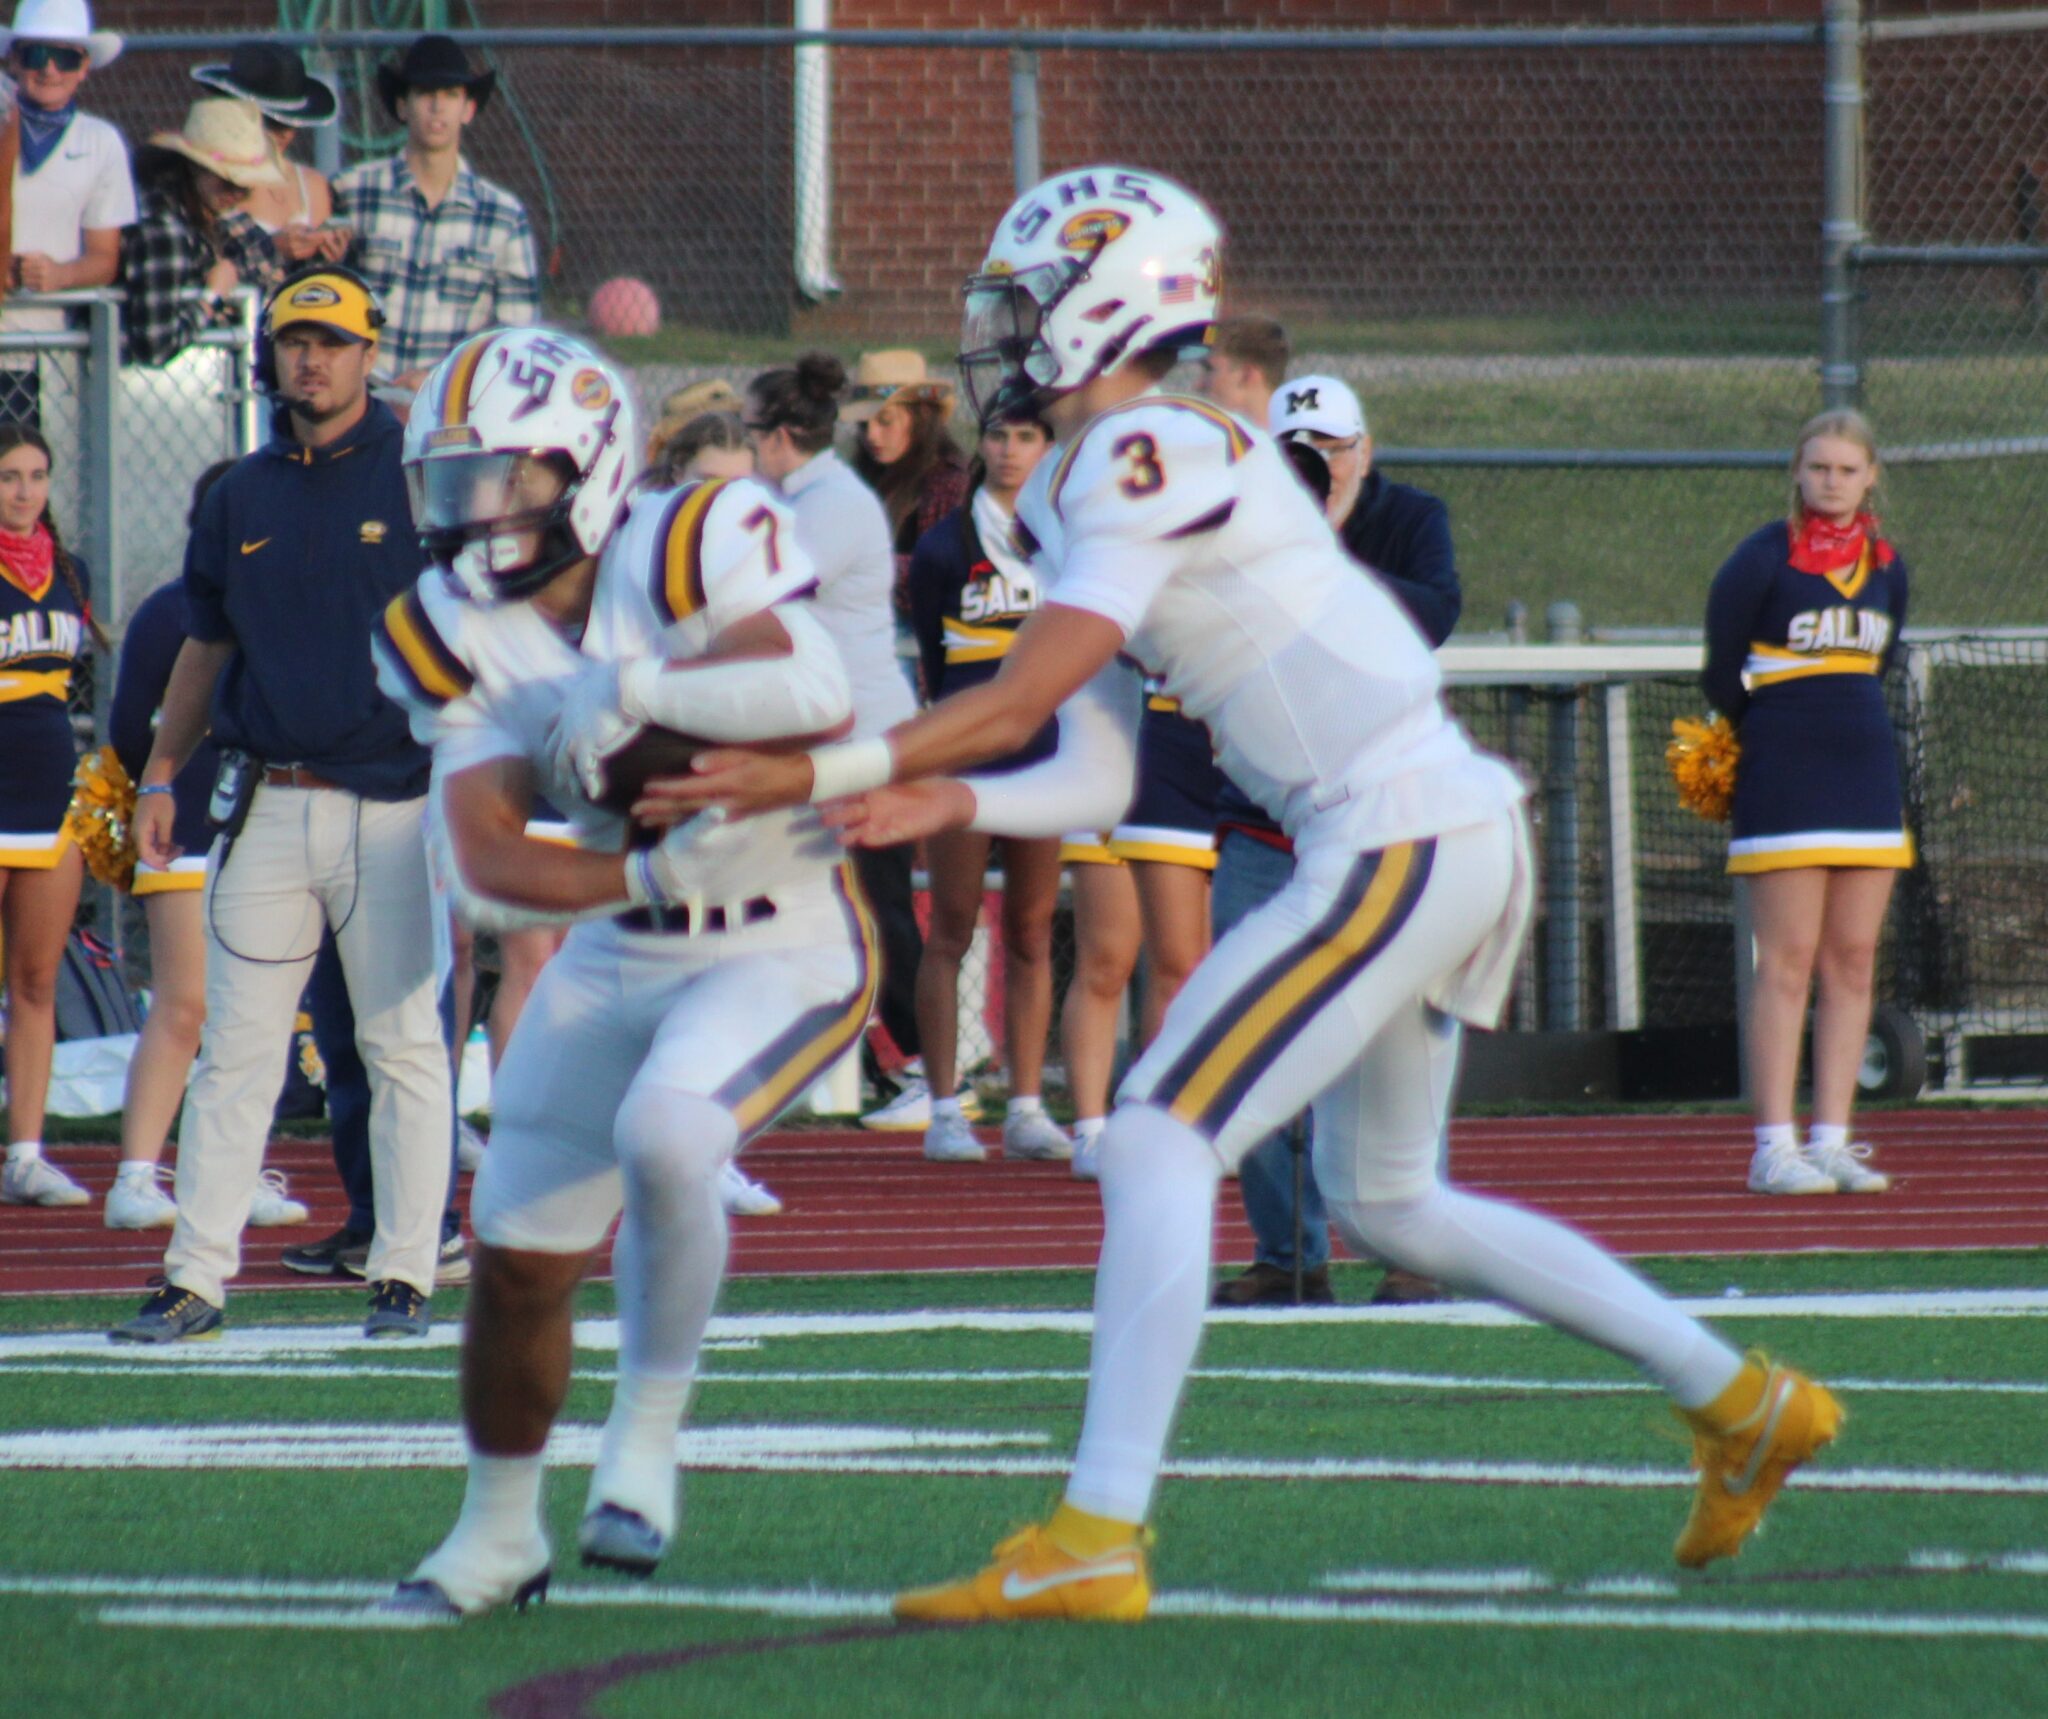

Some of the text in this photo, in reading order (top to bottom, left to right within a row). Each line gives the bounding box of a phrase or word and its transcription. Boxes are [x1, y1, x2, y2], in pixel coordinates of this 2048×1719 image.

[1011, 172, 1163, 246] SHS
[1286, 388, 1319, 414] M
[1111, 430, 1167, 499] 3
[739, 503, 783, 577] 7
